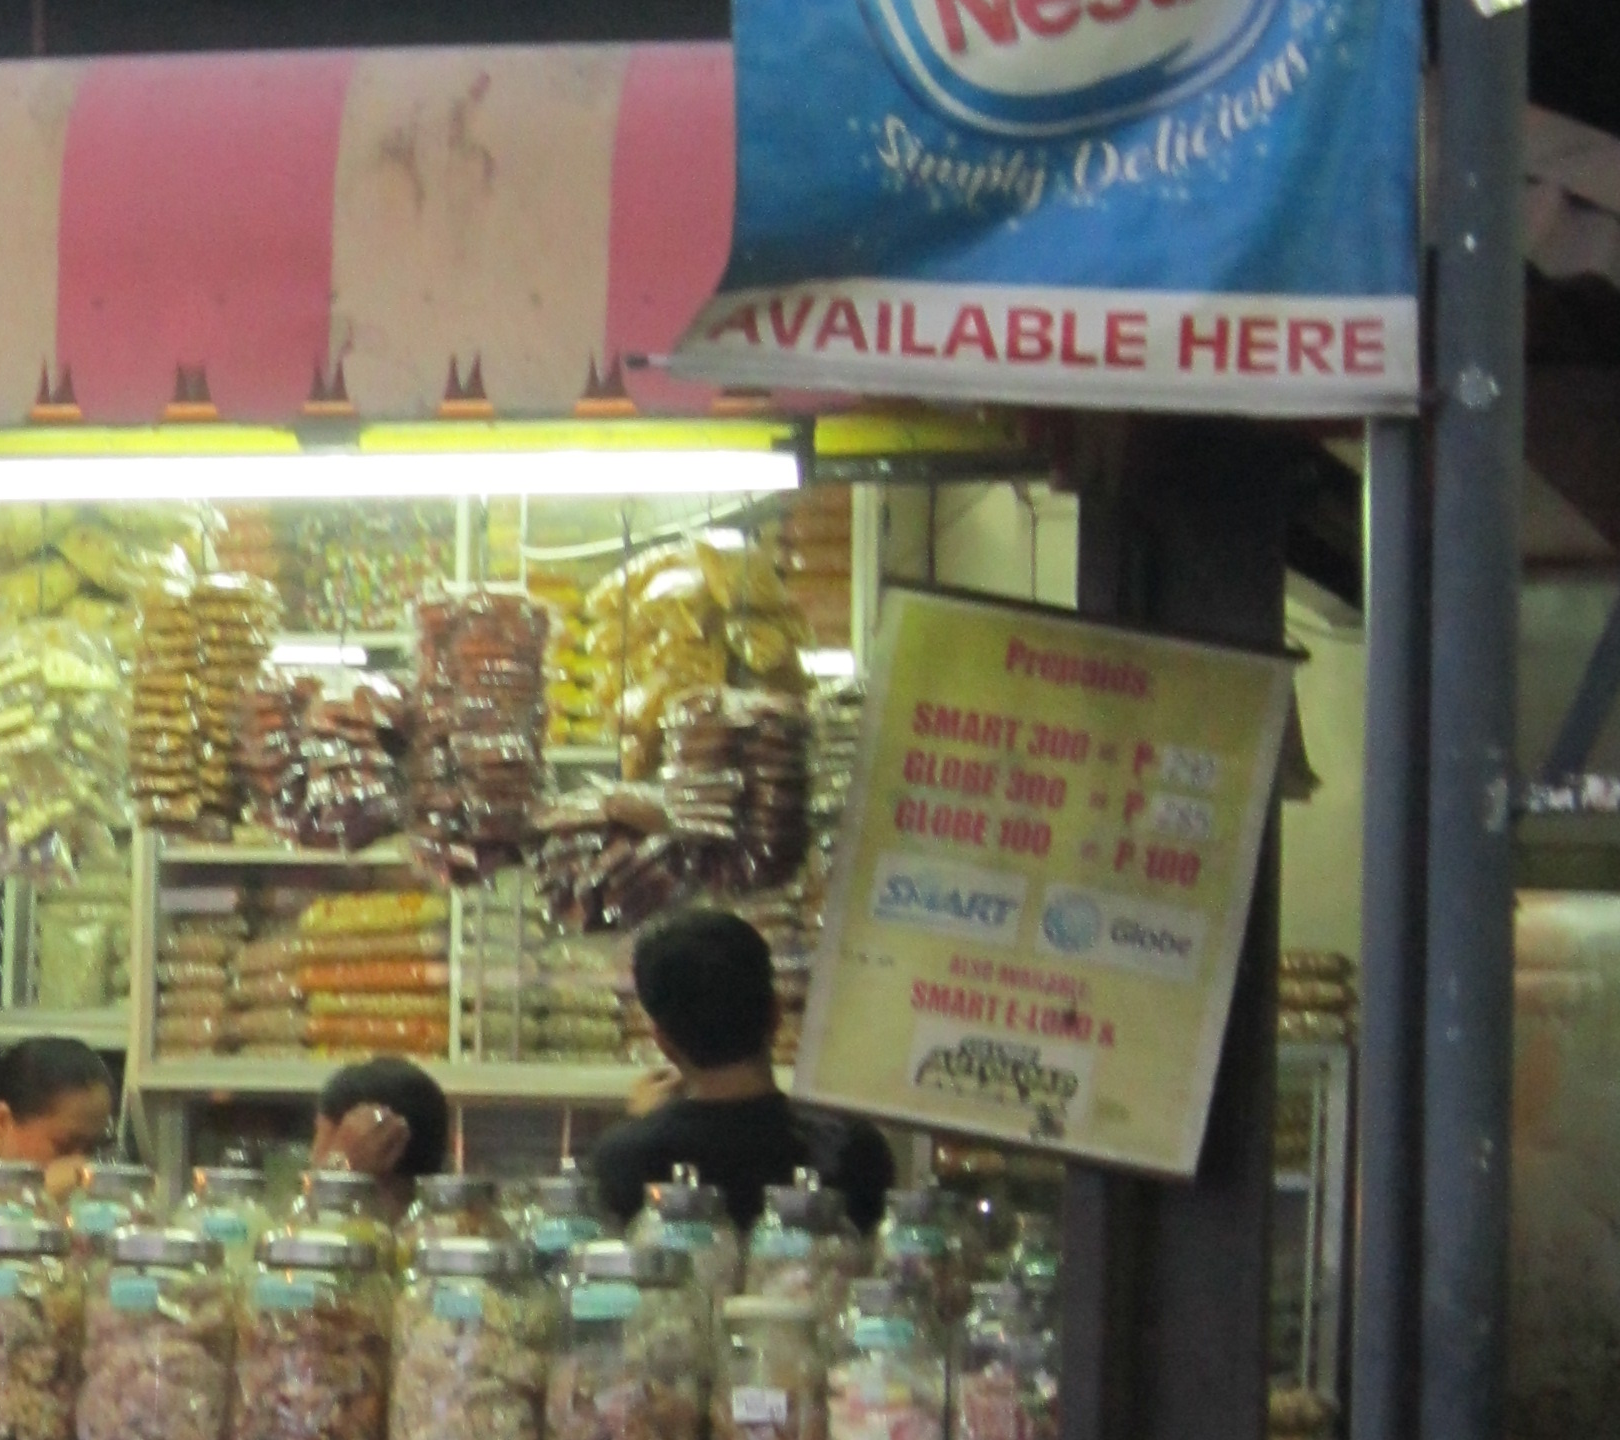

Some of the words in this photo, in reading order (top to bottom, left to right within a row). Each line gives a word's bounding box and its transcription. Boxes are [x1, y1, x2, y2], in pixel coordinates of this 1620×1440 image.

[706, 294, 1147, 370] AVAILABLE
[1180, 316, 1385, 378] HERE
[913, 700, 1022, 751] SMART
[1028, 721, 1090, 764] 300
[904, 748, 998, 795] GLOBE
[894, 795, 988, 847] GLOBE
